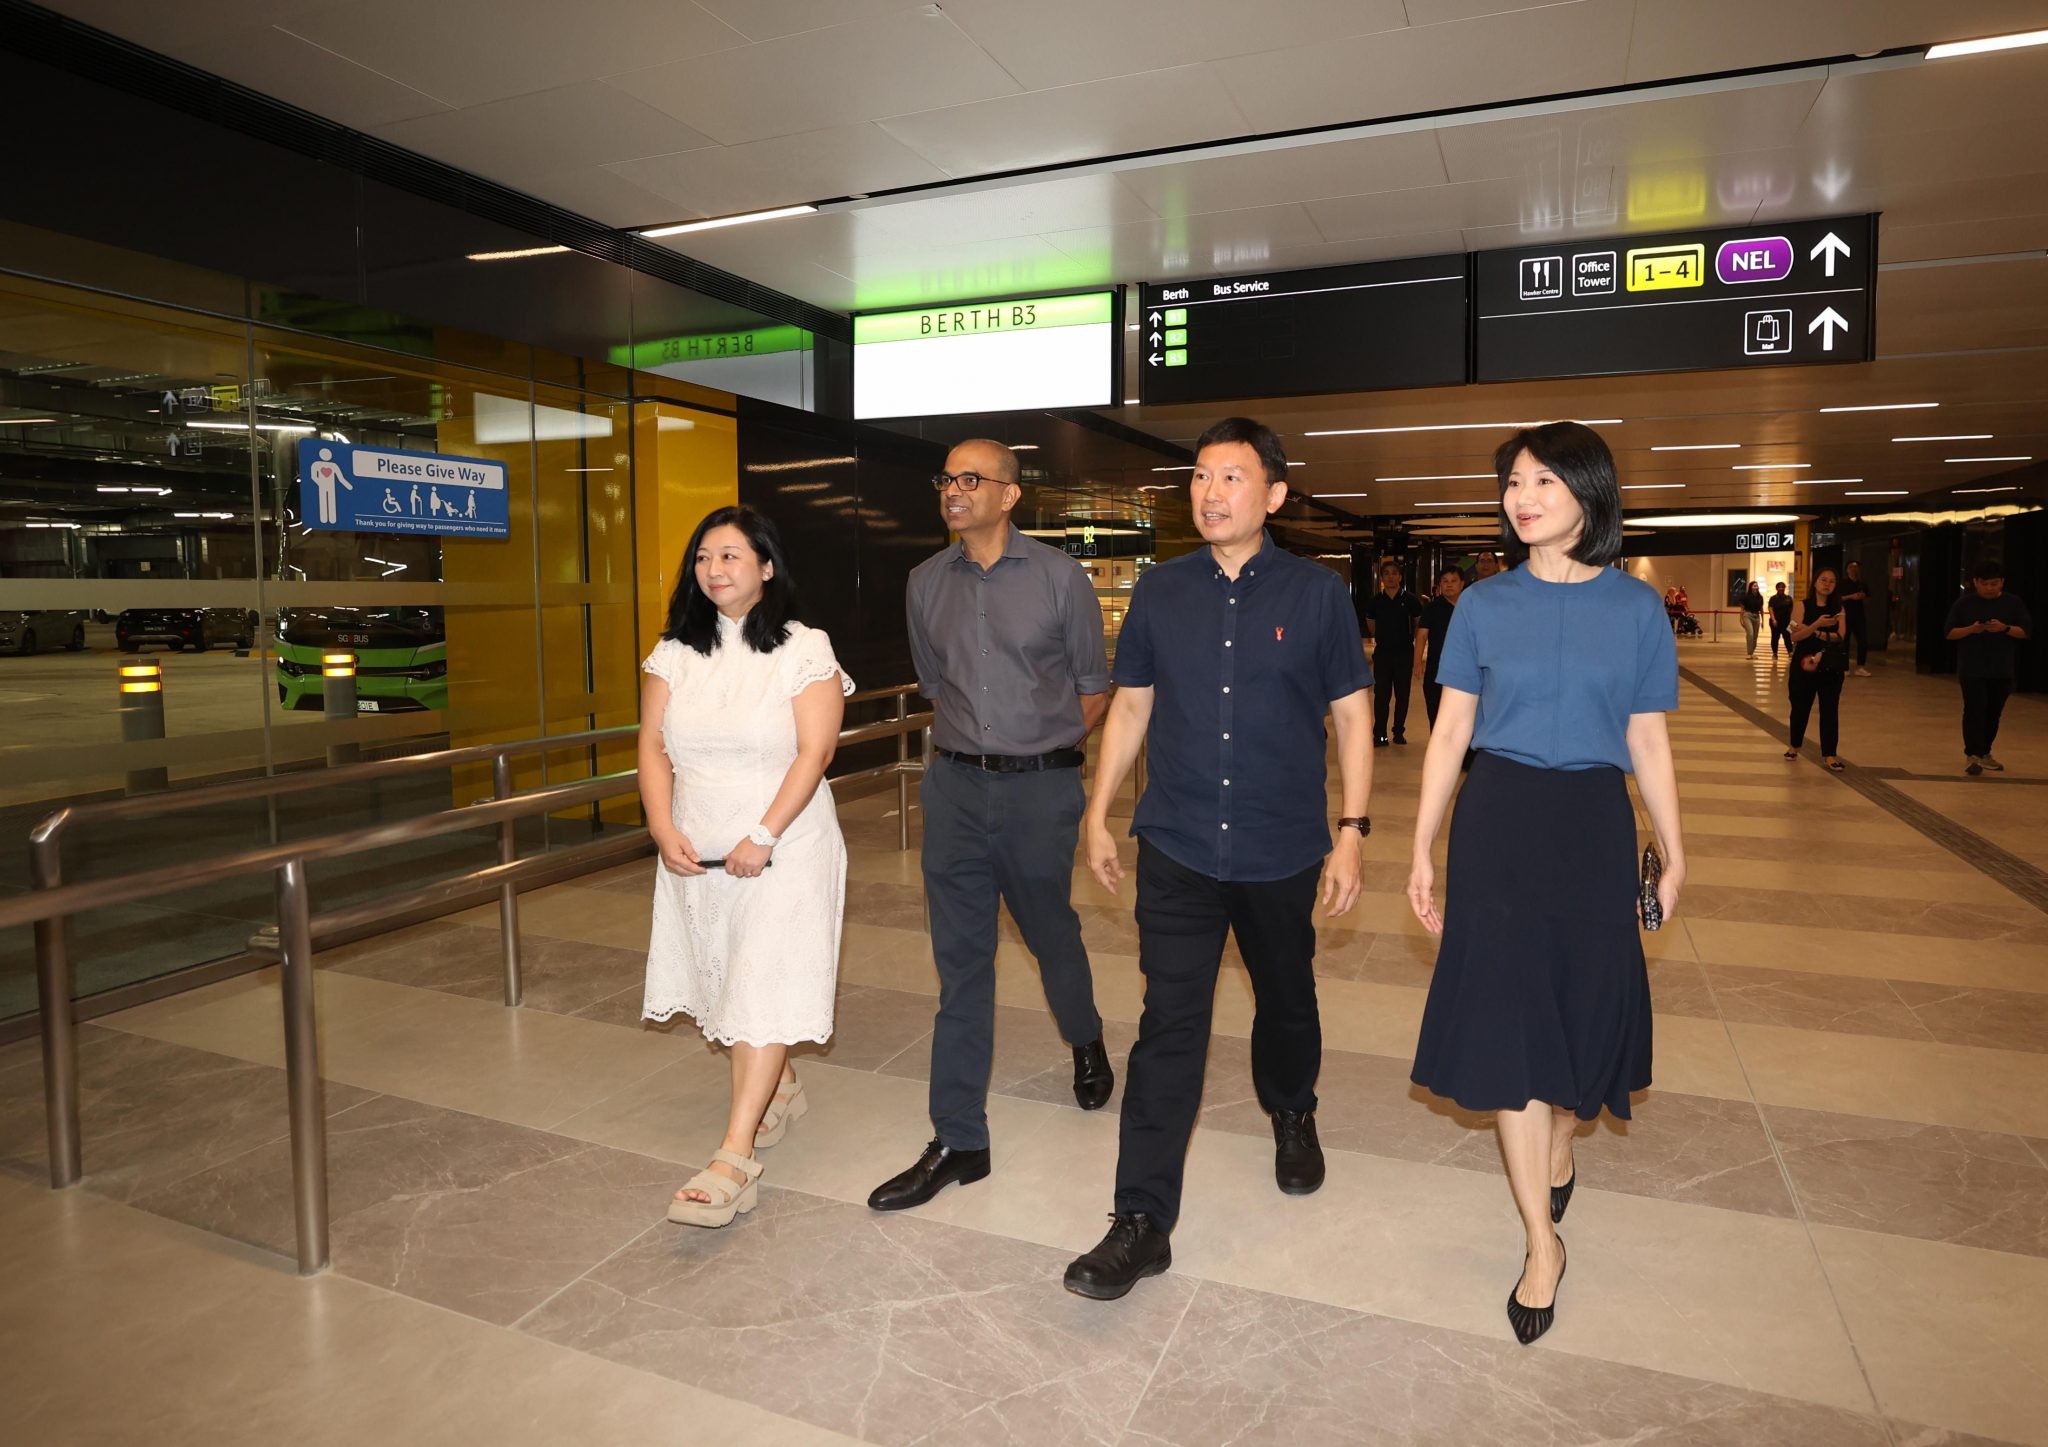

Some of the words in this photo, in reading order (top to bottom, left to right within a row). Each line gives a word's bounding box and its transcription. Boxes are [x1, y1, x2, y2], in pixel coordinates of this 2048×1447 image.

[1578, 261, 1610, 275] Office
[1732, 250, 1776, 272] NEL
[1213, 282, 1231, 297] Bus
[1233, 280, 1270, 295] Service
[1578, 274, 1611, 289] Tower
[1163, 286, 1189, 302] Berth
[1523, 289, 1541, 297] Hawker
[921, 309, 1001, 335] BERTH
[1012, 304, 1036, 327] B3
[377, 458, 422, 476] Please
[425, 463, 455, 480] Give
[457, 467, 486, 485] Way
[355, 519, 374, 527] Thank
[374, 521, 386, 529] you
[387, 520, 396, 528] for
[396, 521, 415, 530] giving
[434, 524, 464, 533] passengers
